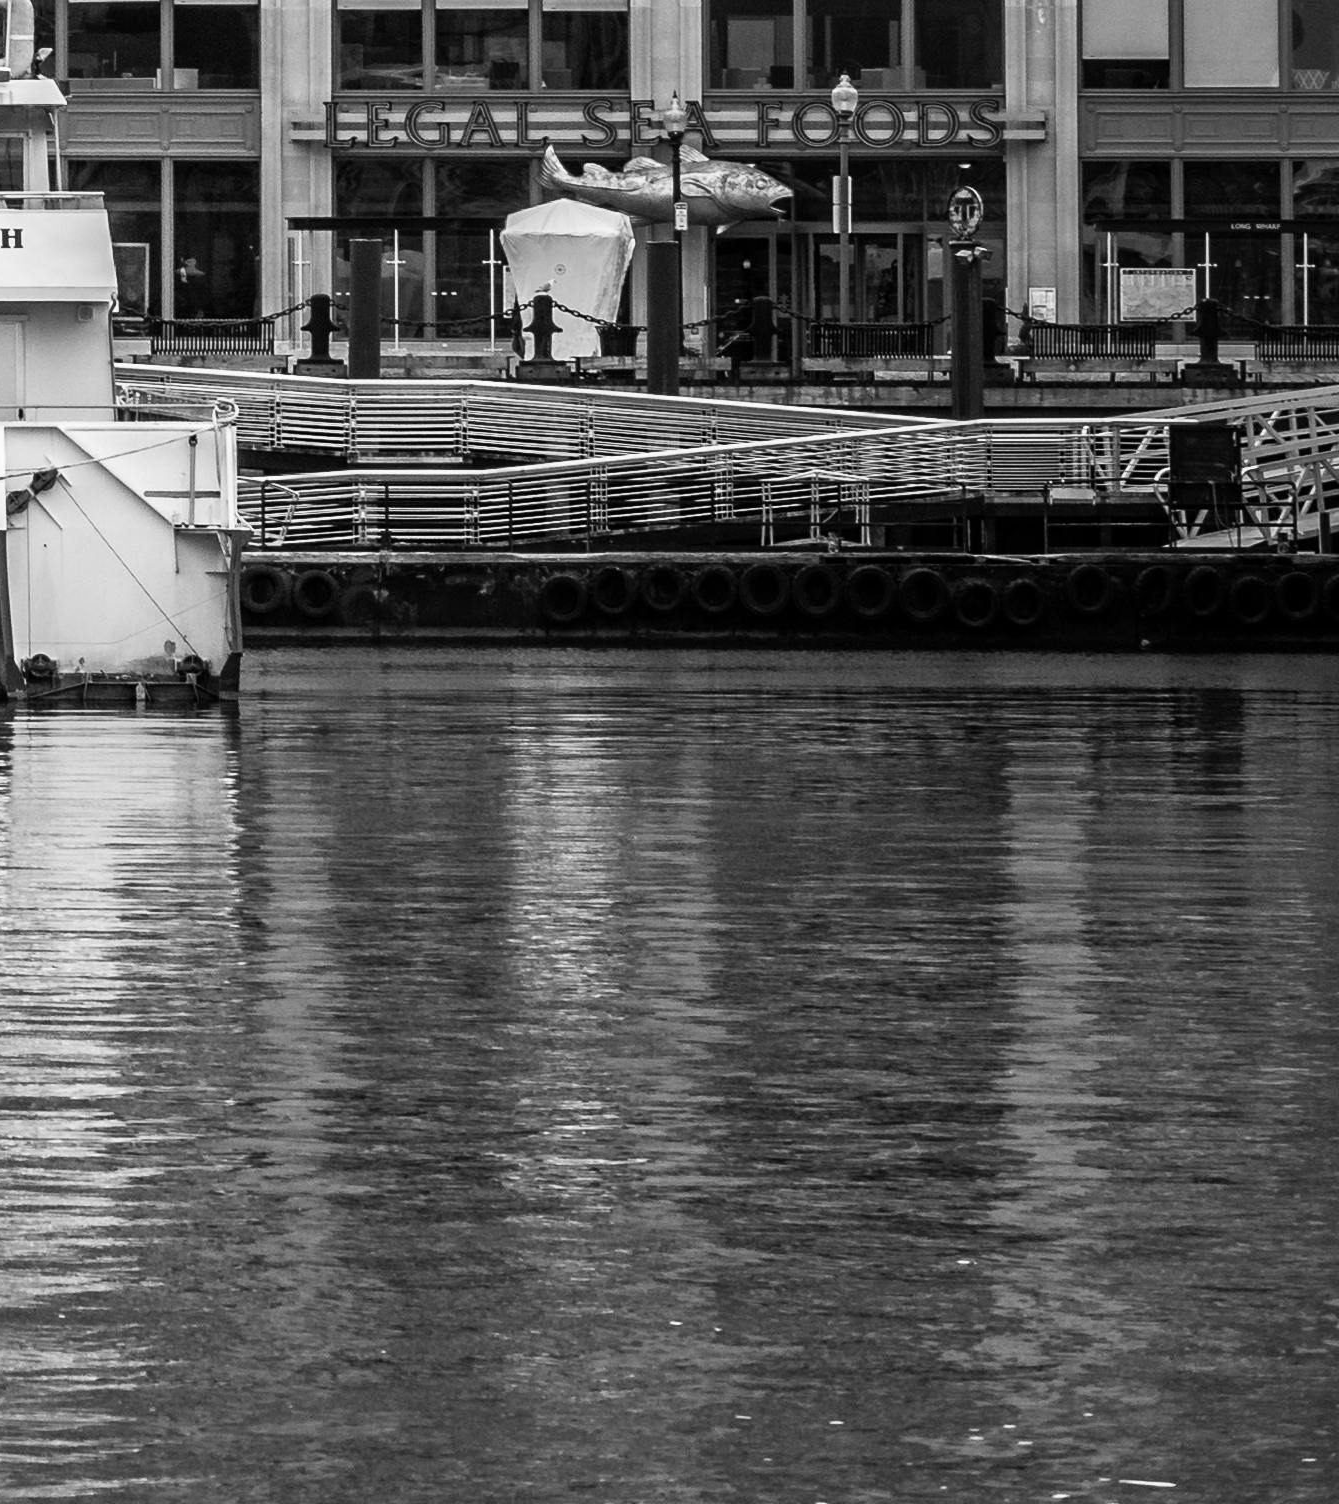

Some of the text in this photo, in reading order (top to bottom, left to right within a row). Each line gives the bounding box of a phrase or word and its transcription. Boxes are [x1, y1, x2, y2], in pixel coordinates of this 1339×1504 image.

[323, 100, 1003, 148] LEGAL SEA FOODS
